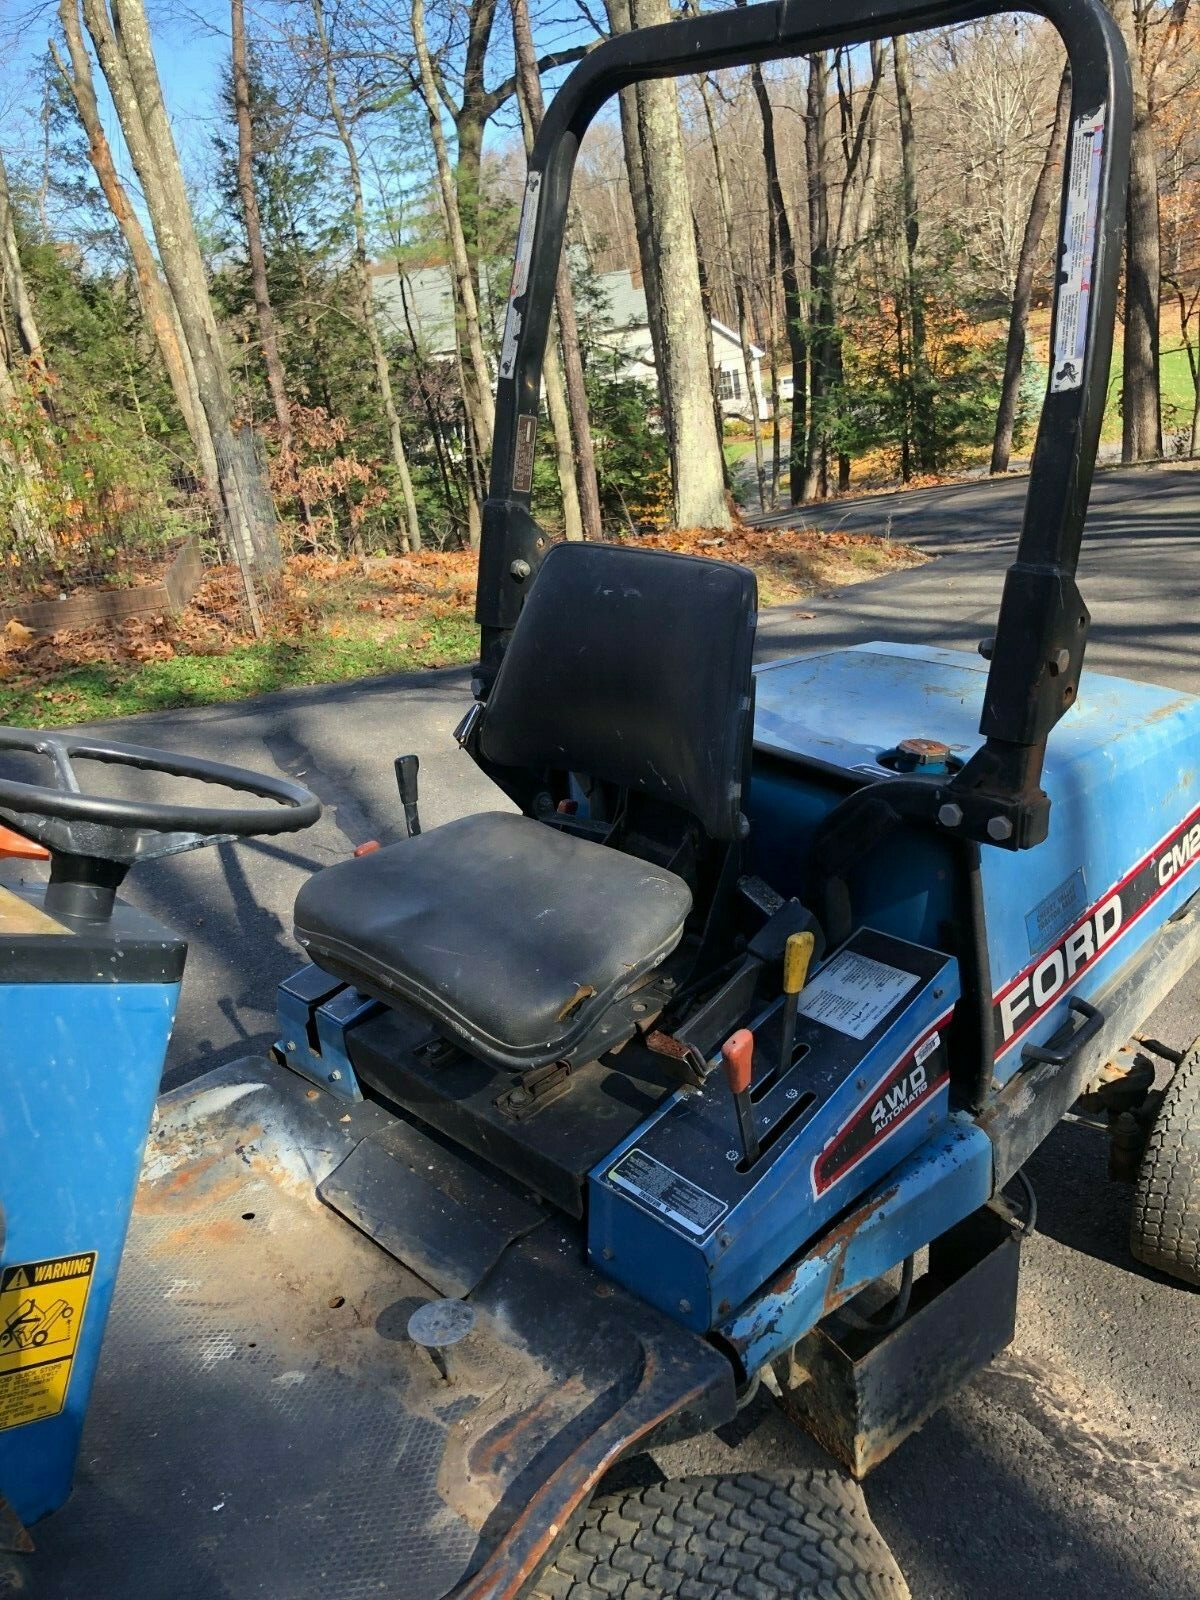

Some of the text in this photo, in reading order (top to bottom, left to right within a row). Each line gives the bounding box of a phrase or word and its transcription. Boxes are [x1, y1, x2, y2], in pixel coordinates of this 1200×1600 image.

[1000, 894, 1122, 1042] FORD
[871, 1065, 926, 1124] 4WD
[874, 1081, 928, 1135] AUTOMATIC
[34, 1256, 92, 1284] WARNING
